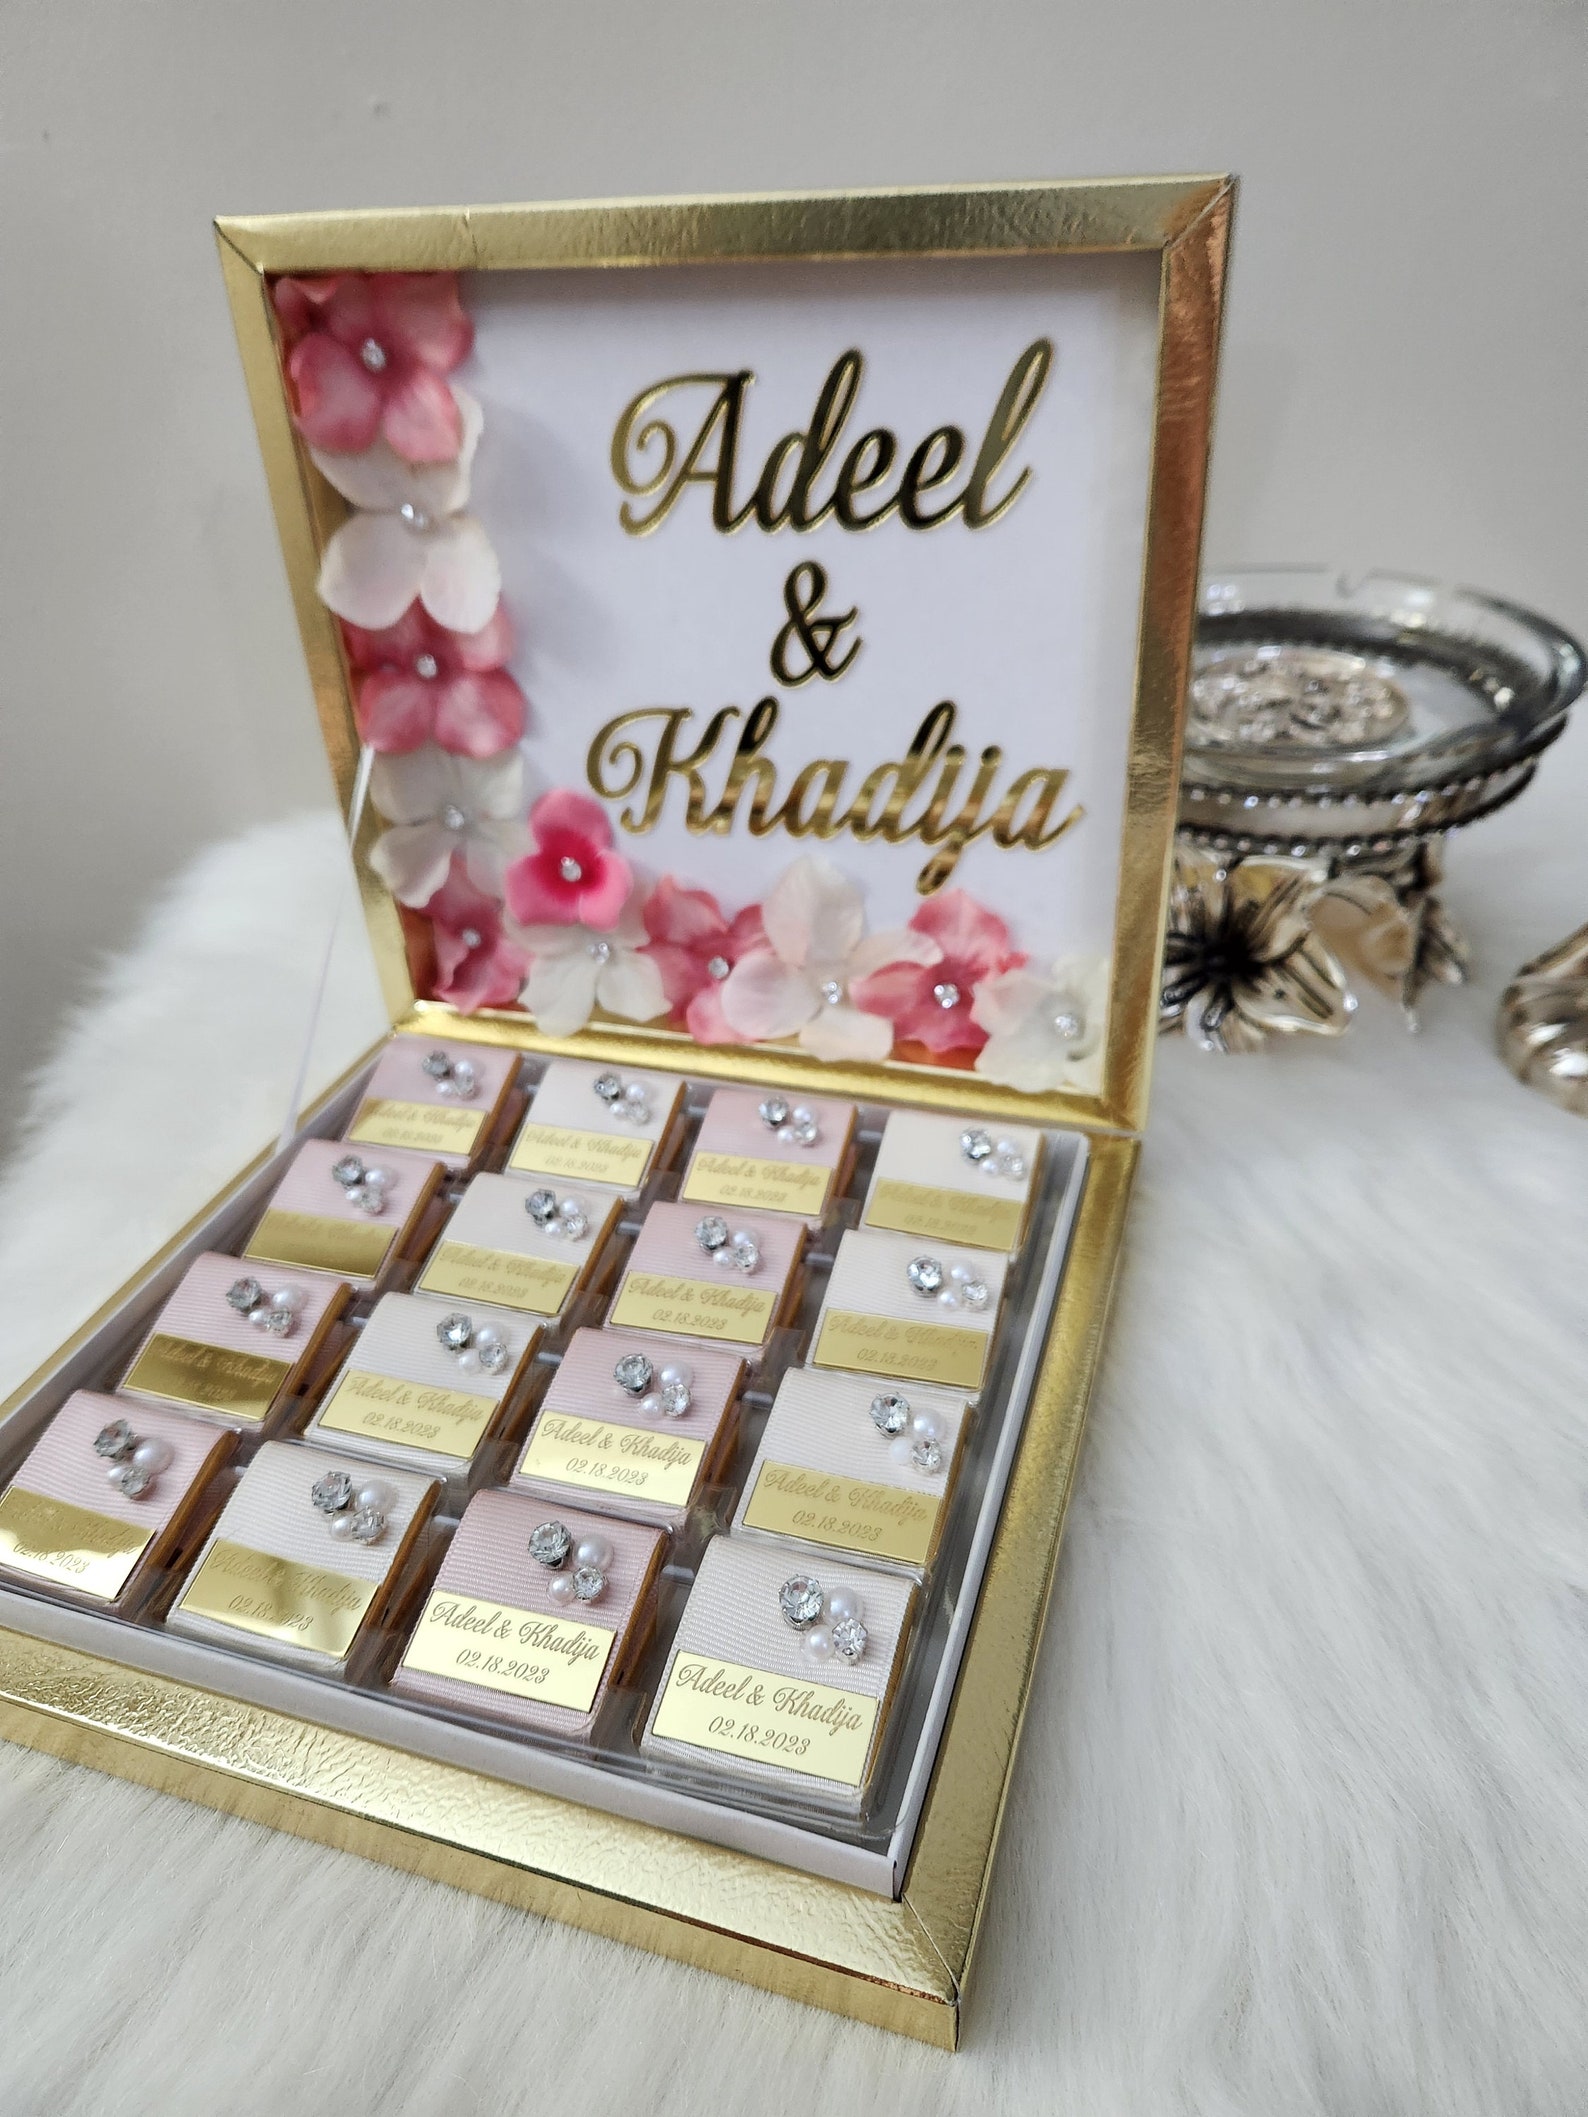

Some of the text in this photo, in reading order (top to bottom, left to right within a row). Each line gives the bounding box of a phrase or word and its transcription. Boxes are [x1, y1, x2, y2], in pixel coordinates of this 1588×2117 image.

[611, 336, 1054, 536] Adeel
[770, 560, 862, 687] &
[586, 696, 1085, 895] Khadija
[628, 1278, 766, 1317] Adeel & Khadija
[653, 1309, 728, 1330] 02.18.2023
[346, 1376, 484, 1426] Adeel & Khadija
[362, 1411, 441, 1439] 02.18.2023
[541, 1418, 693, 1470] Adeel & Khadija
[566, 1457, 649, 1486] 02.18.2023
[764, 1469, 927, 1526] Adeel & Khadija
[792, 1510, 883, 1541] 02.18.2023
[13, 1541, 90, 1574] 02.182023
[429, 1601, 601, 1666] Adeel & Khadija
[456, 1648, 550, 1685] 02.18.2023
[675, 1663, 863, 1737] Adeel & Khadija
[708, 1715, 811, 1756] 02.18.2023
